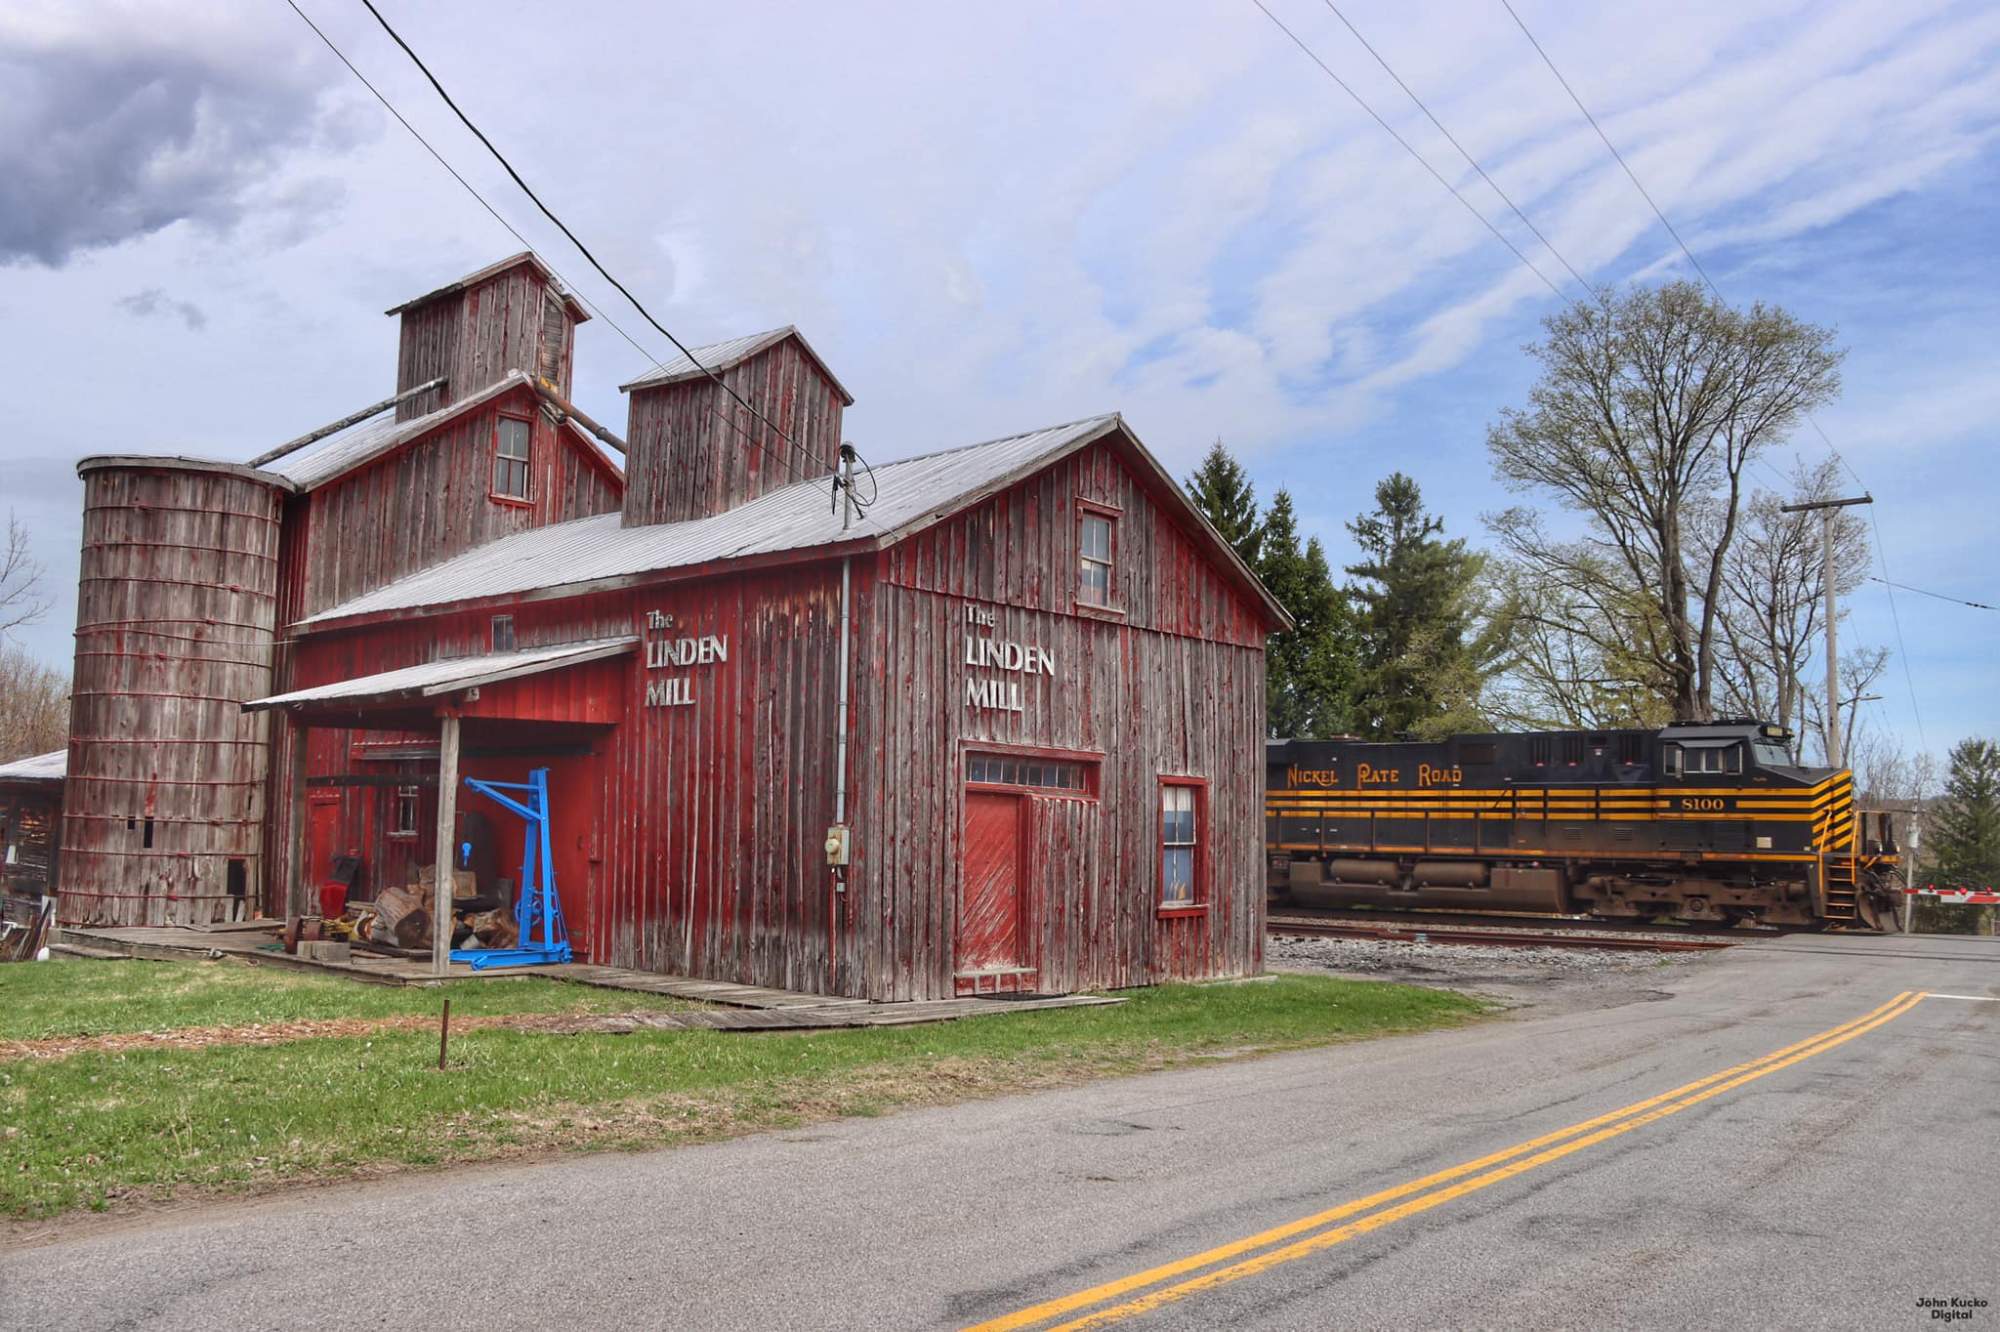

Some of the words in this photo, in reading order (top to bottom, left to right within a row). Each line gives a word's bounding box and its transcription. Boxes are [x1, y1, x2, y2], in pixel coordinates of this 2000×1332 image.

[646, 610, 673, 629] The
[964, 603, 995, 627] The
[646, 633, 728, 668] LINDEN
[966, 635, 1055, 676] LINDEN
[645, 677, 696, 706] MILL
[966, 677, 1024, 711] MILL
[1287, 764, 1339, 789] NICKEL
[1418, 763, 1463, 787] ROAD
